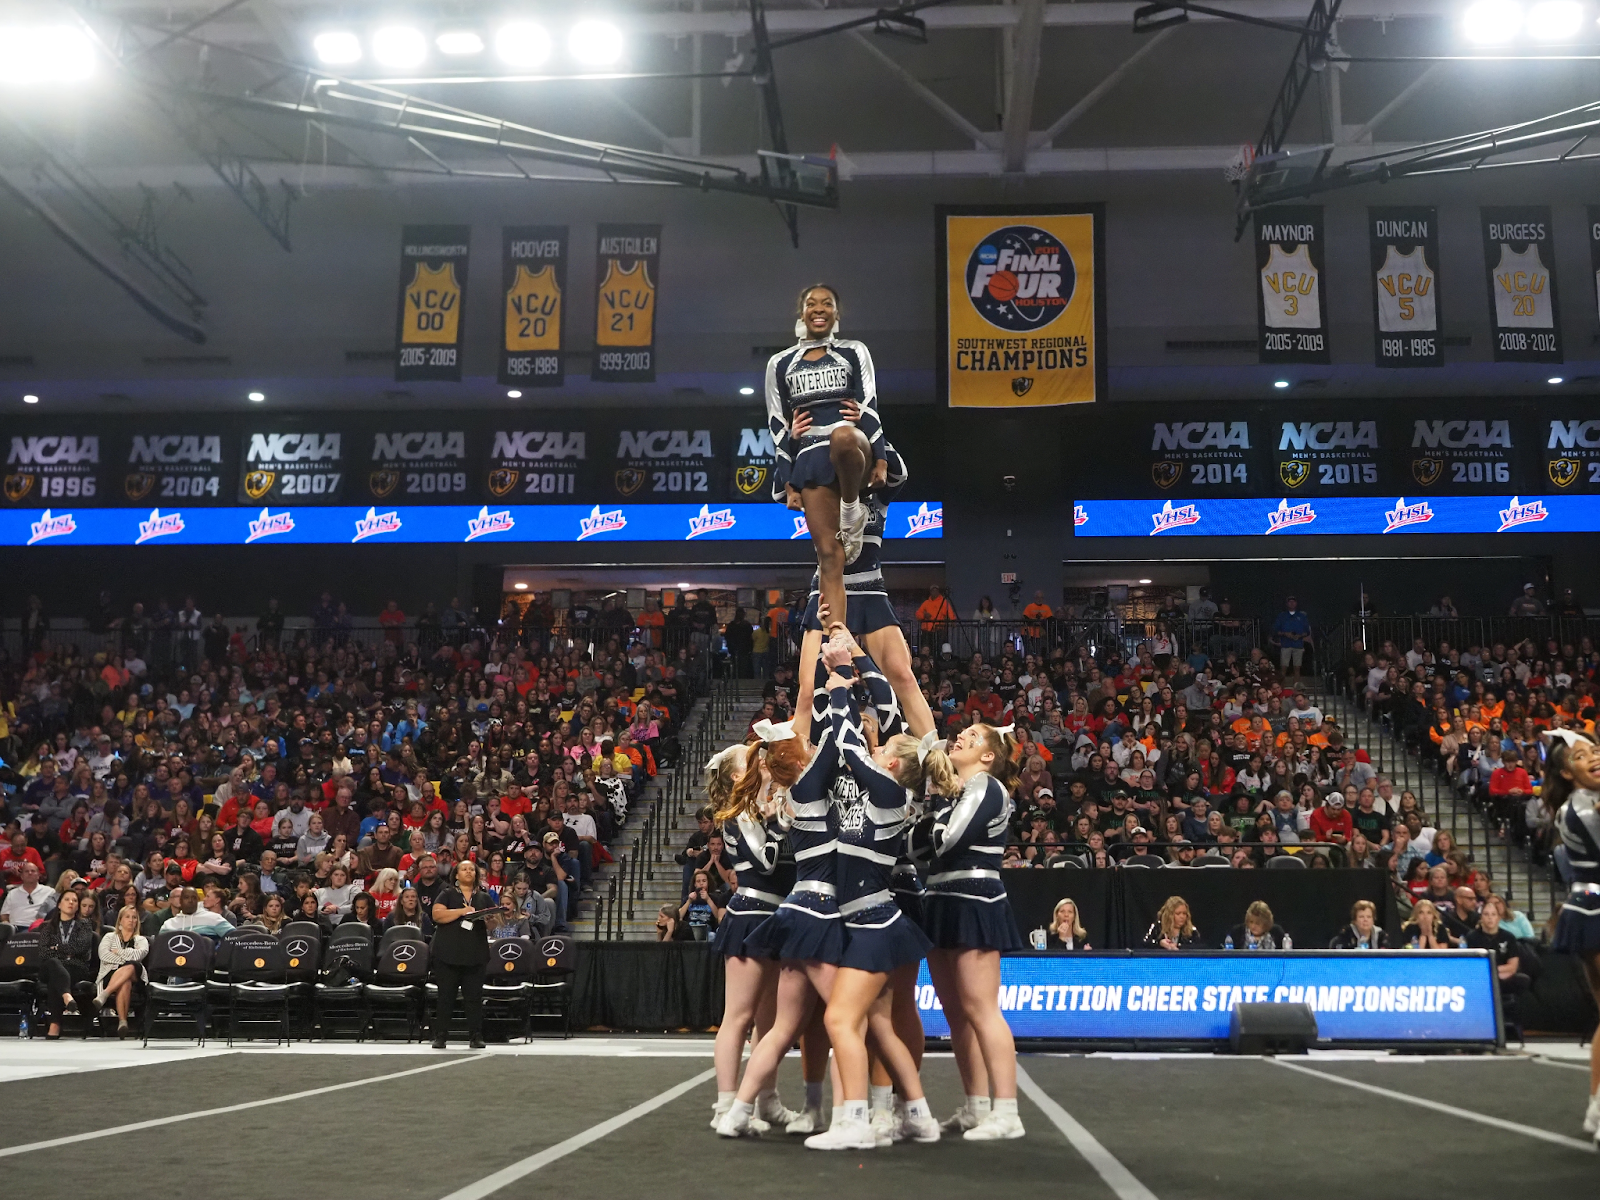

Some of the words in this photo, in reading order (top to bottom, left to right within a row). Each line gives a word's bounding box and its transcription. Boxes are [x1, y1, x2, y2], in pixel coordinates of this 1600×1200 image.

[1262, 225, 1314, 241] MAYNOR
[1376, 220, 1428, 238] DUNCAN
[1490, 223, 1545, 240] BURGESS
[511, 240, 559, 258] HOOVER
[600, 237, 657, 254] AUSTGULEN
[1035, 247, 1059, 255] 2011
[997, 249, 1061, 272] FINAL
[1265, 272, 1315, 295] VCU
[1379, 274, 1432, 297] VCU
[1498, 271, 1546, 295] VCU
[410, 290, 456, 311] VCU
[511, 294, 557, 316] VCU
[604, 289, 650, 310] VCU
[1015, 298, 1067, 306] HOUSTON
[1284, 295, 1298, 316] 3
[1399, 297, 1414, 321] 5
[1512, 296, 1535, 316] 20
[418, 312, 444, 331] 00
[519, 318, 546, 337] 20
[611, 313, 634, 331] 21
[957, 338, 1028, 350] SOUTHWEST
[1031, 336, 1087, 349] REGIONAL
[1265, 333, 1324, 351] 2005-2009
[1499, 333, 1556, 352] 2008-2012
[507, 357, 558, 375] 1985-1989
[600, 352, 650, 370] 1999-2003
[957, 348, 1087, 371] CHAMPIONS
[786, 367, 847, 396] MAVERICKS
[616, 430, 712, 458] NCAA
[1151, 421, 1250, 450] NCAA
[1279, 421, 1379, 450] NCAA
[1411, 420, 1512, 448] NCAA
[7, 436, 99, 464] NCAA
[129, 435, 221, 463] NCAA
[247, 433, 341, 462] NCAA
[372, 432, 464, 460] NCAA
[491, 431, 586, 459] NCAA
[406, 472, 467, 493] 2009
[652, 471, 708, 492] 2012
[1191, 463, 1248, 484] 2014
[1318, 463, 1378, 485] 2015
[1452, 462, 1510, 483] 2016
[41, 476, 97, 497] 1996
[160, 476, 220, 496] 2004
[281, 474, 341, 495] 2007
[525, 473, 575, 494] 2011
[358, 514, 397, 533] VHSL
[470, 513, 512, 532] VHSL
[582, 512, 623, 532] VHSL
[691, 511, 733, 531] VHSL
[1155, 506, 1197, 527] VHSL
[1270, 504, 1313, 525] VHSL
[1386, 504, 1429, 525] VHSL
[1500, 502, 1542, 524] VHSL
[251, 515, 290, 534] VHSL
[329, 942, 369, 950] Mercedes-Benz
[1127, 985, 1198, 1012] CHEER
[1202, 986, 1269, 1012] STATE
[1274, 986, 1466, 1012] CHAMPIONSHIPS
